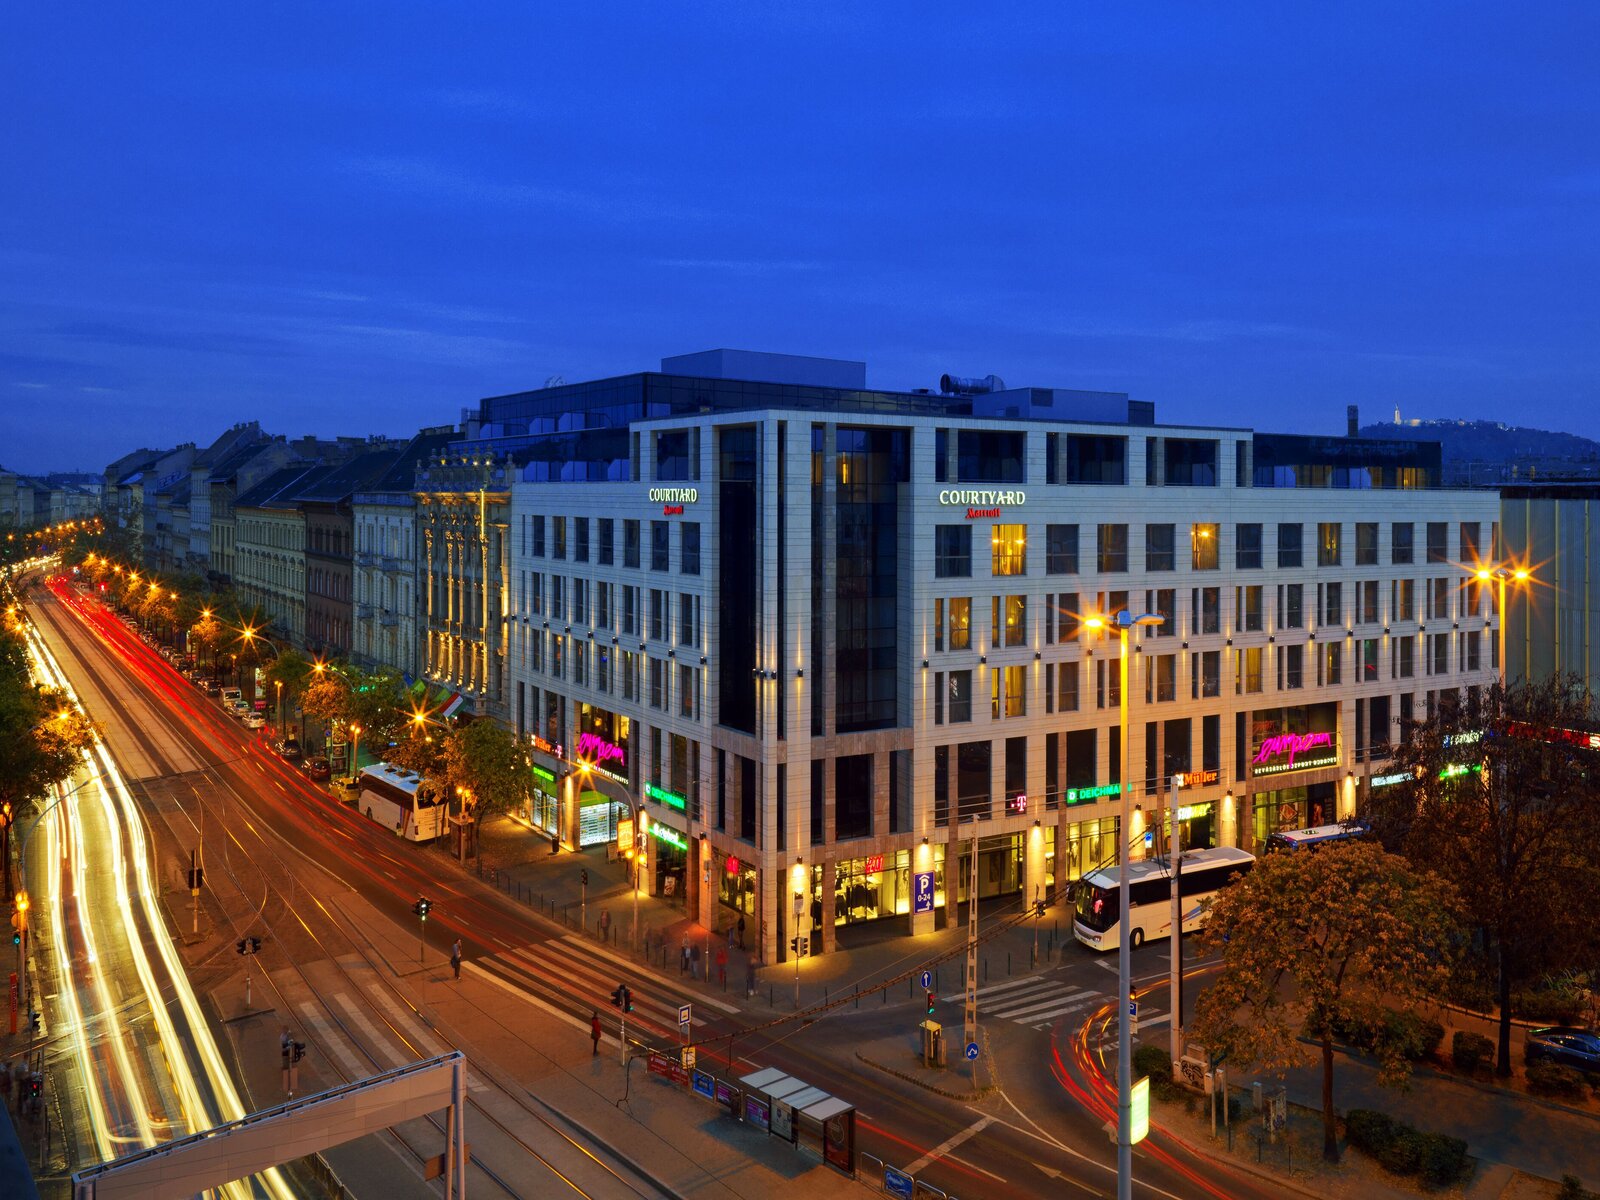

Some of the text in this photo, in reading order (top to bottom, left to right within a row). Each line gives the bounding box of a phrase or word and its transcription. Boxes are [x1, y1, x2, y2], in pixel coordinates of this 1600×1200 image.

[649, 488, 698, 503] COURTYARD
[939, 490, 1026, 505] COURTYARD
[965, 507, 1001, 519] Marriott
[1184, 771, 1218, 785] Müller
[1080, 783, 1133, 800] DEICHMA
[920, 876, 929, 894] P
[917, 893, 931, 902] 0-24
